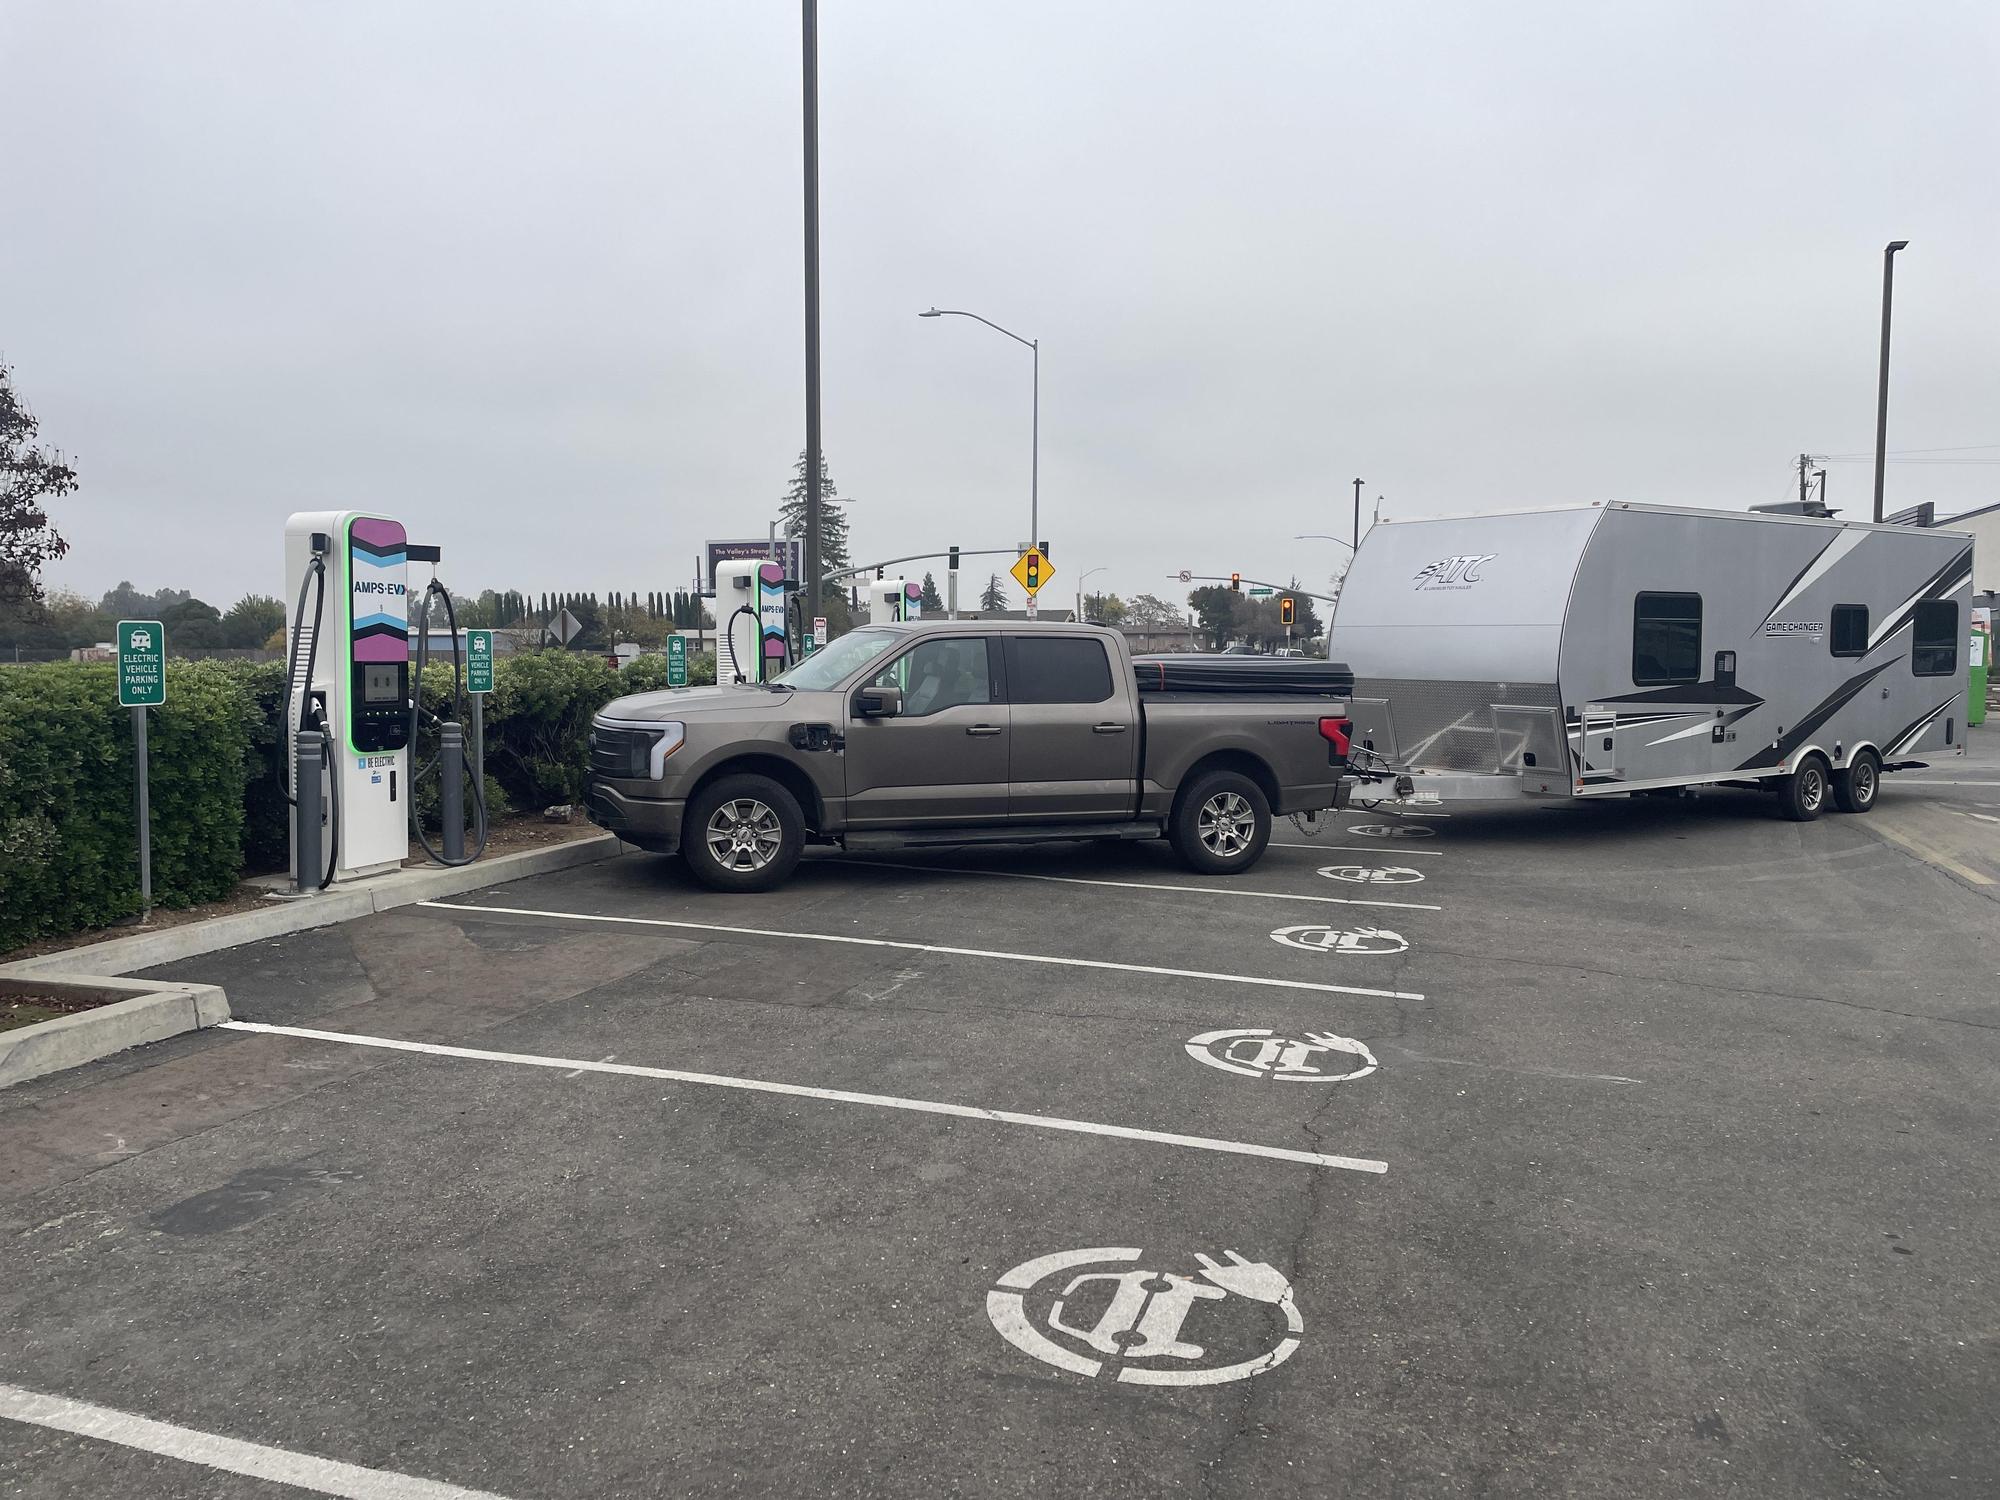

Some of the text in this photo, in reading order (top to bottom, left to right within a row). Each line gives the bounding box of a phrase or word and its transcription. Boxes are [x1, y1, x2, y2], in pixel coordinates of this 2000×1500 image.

[1434, 553, 1498, 583] ATC
[124, 654, 158, 662] ELECTRIC
[126, 665, 157, 673] VEHICLE
[126, 676, 158, 684] PARKING
[132, 686, 152, 694] ONLY
[368, 757, 374, 768] BE
